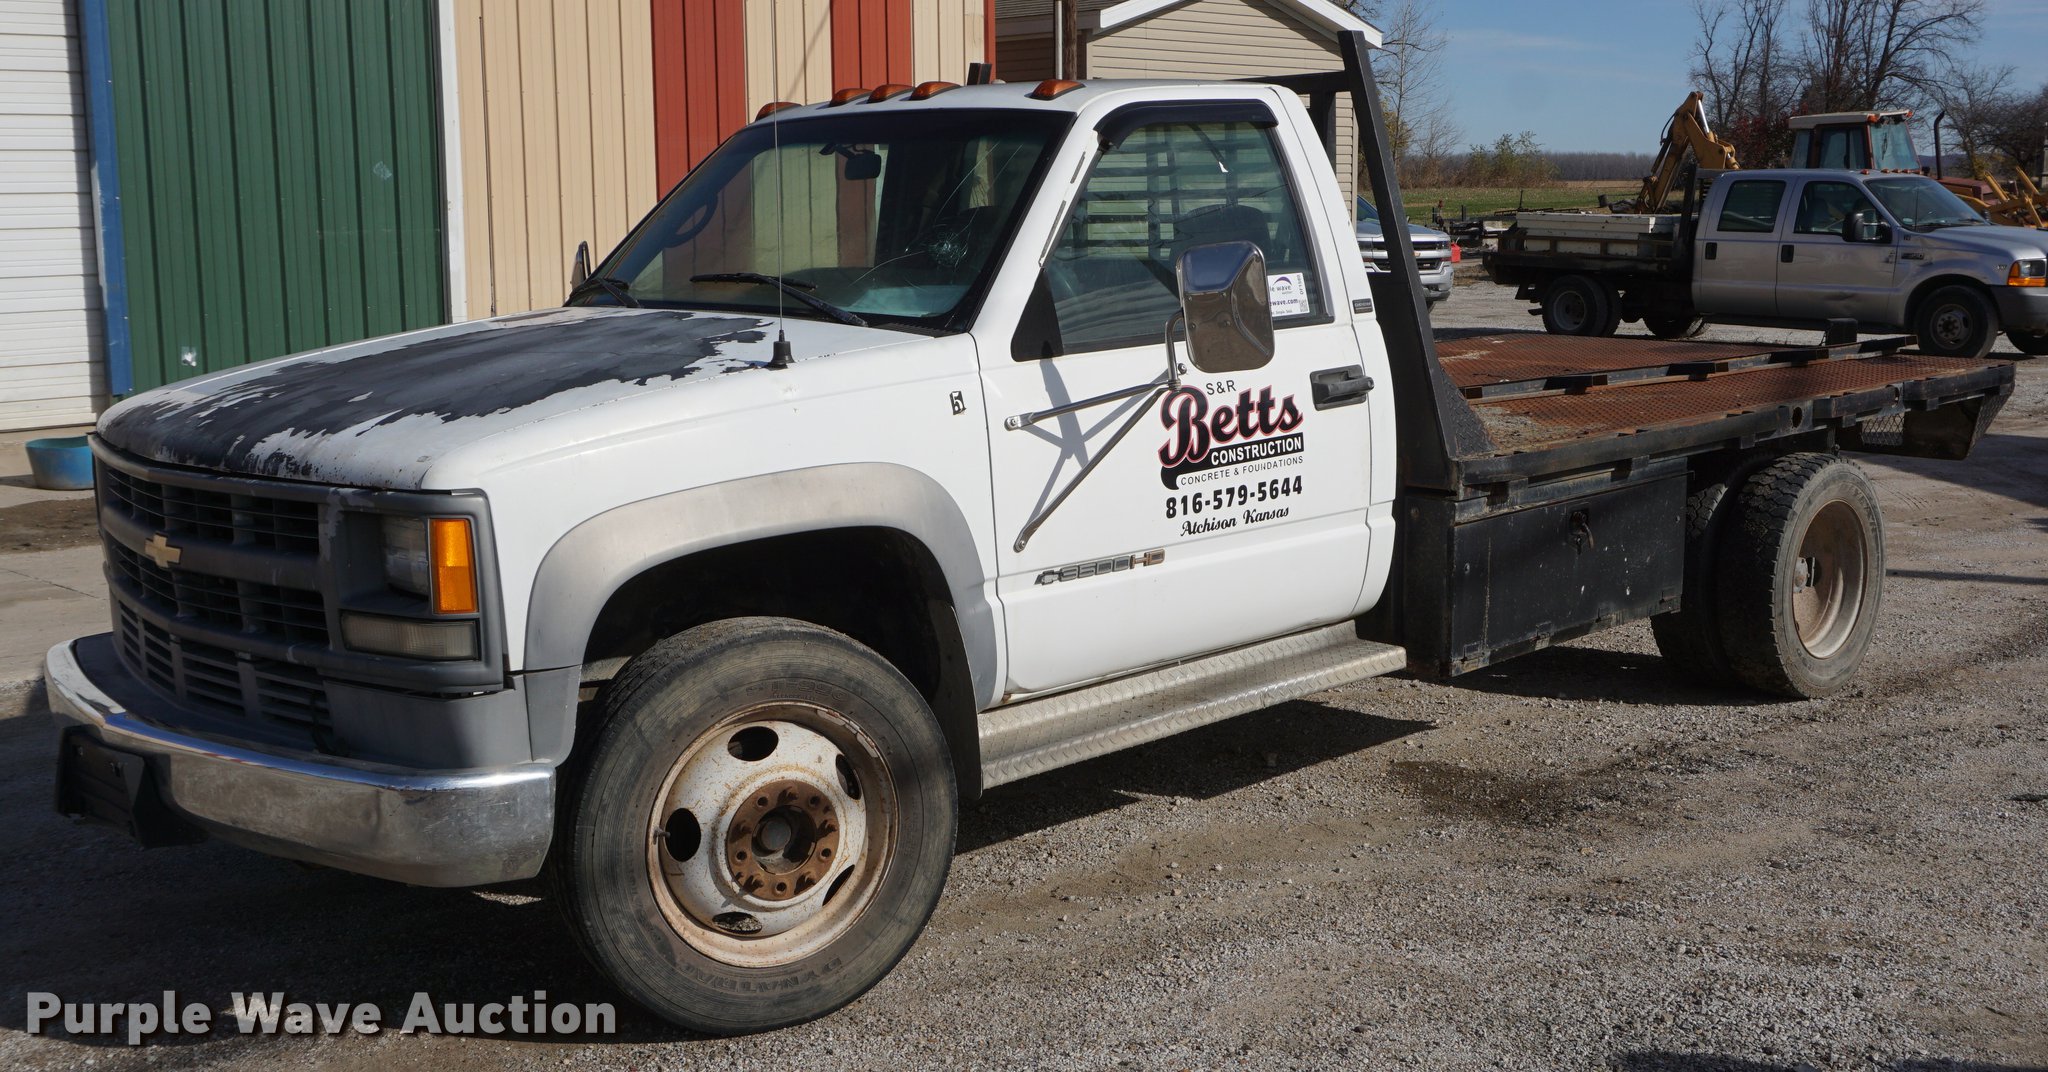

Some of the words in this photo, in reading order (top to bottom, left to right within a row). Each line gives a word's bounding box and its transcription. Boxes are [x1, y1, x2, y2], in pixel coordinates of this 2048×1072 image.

[1205, 379, 1237, 396] S&R
[1158, 384, 1304, 468] Betts
[1211, 436, 1303, 466] CONSTRUCTION
[1180, 470, 1231, 486] CONCRETE
[1233, 467, 1239, 476] &
[1242, 455, 1304, 475] FOUNDATIONS
[1166, 475, 1303, 519] 816-579-5644
[1180, 516, 1237, 537] Atchison
[1242, 506, 1290, 525] Kansas
